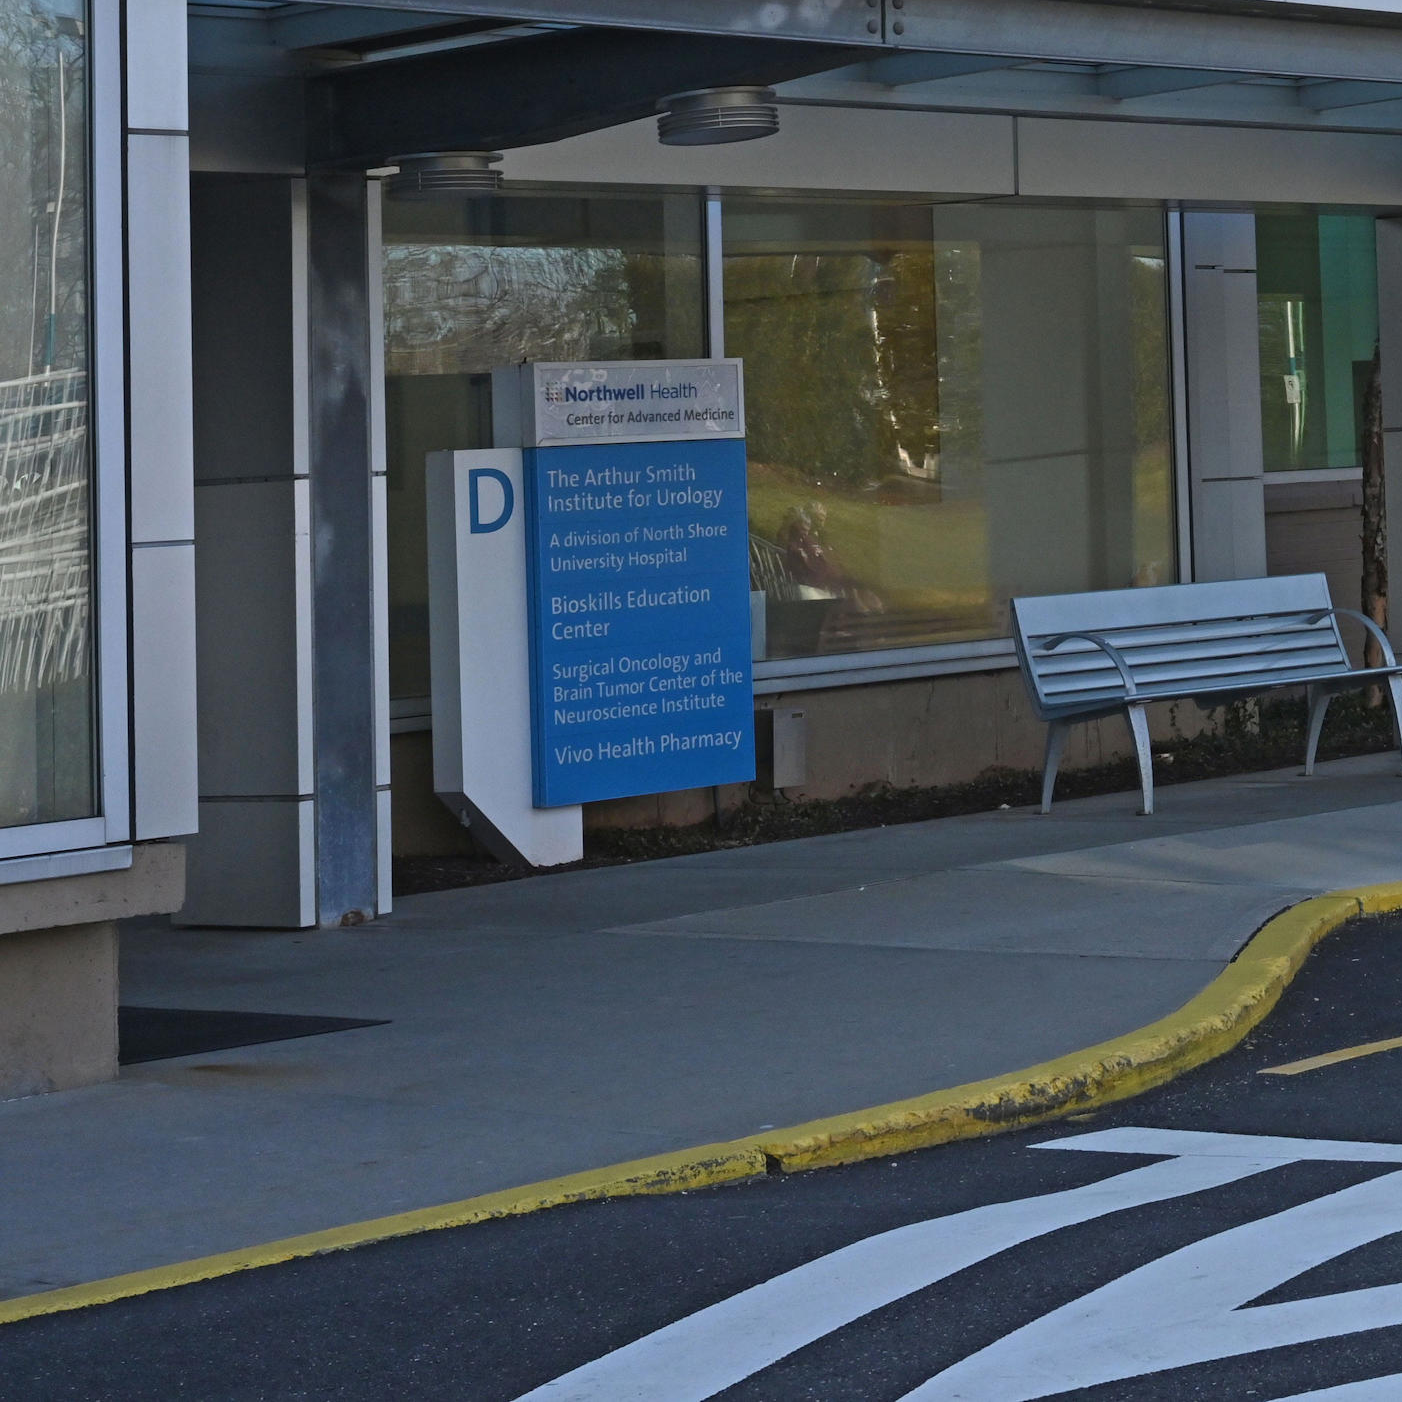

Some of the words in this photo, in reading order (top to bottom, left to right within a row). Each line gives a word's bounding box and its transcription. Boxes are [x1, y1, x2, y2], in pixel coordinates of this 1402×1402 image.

[565, 383, 645, 402] Northwell
[650, 382, 698, 399] Health
[566, 413, 605, 426] Center
[608, 411, 625, 424] for
[627, 409, 681, 424] Advanced
[683, 407, 735, 421] Medicine
[547, 469, 580, 488] The
[584, 466, 641, 486] Arthur
[646, 463, 696, 483] Smith
[468, 467, 514, 534] D
[548, 491, 623, 512] Institute
[627, 488, 652, 507] for
[656, 486, 723, 509] Urology
[550, 533, 561, 548] A
[564, 530, 621, 547] division
[624, 527, 640, 543] of
[643, 524, 684, 541] North
[687, 523, 728, 539] Shore
[550, 552, 625, 573] University
[628, 547, 688, 568] Hospital
[551, 591, 622, 615] Bioskills
[627, 585, 711, 609] Education
[552, 620, 610, 640] Center
[552, 657, 614, 682] Surgical
[618, 653, 690, 674] Oncology
[694, 647, 721, 665] and
[553, 684, 592, 703] Brain
[596, 680, 645, 698] Tumor
[649, 674, 696, 693] Center
[700, 669, 717, 687] of
[720, 668, 743, 684] the
[554, 702, 658, 725] Neuroscience
[661, 693, 725, 714] Institute
[555, 745, 593, 765] Vivo
[598, 736, 655, 760] Health
[660, 730, 742, 753] Pharmacy
